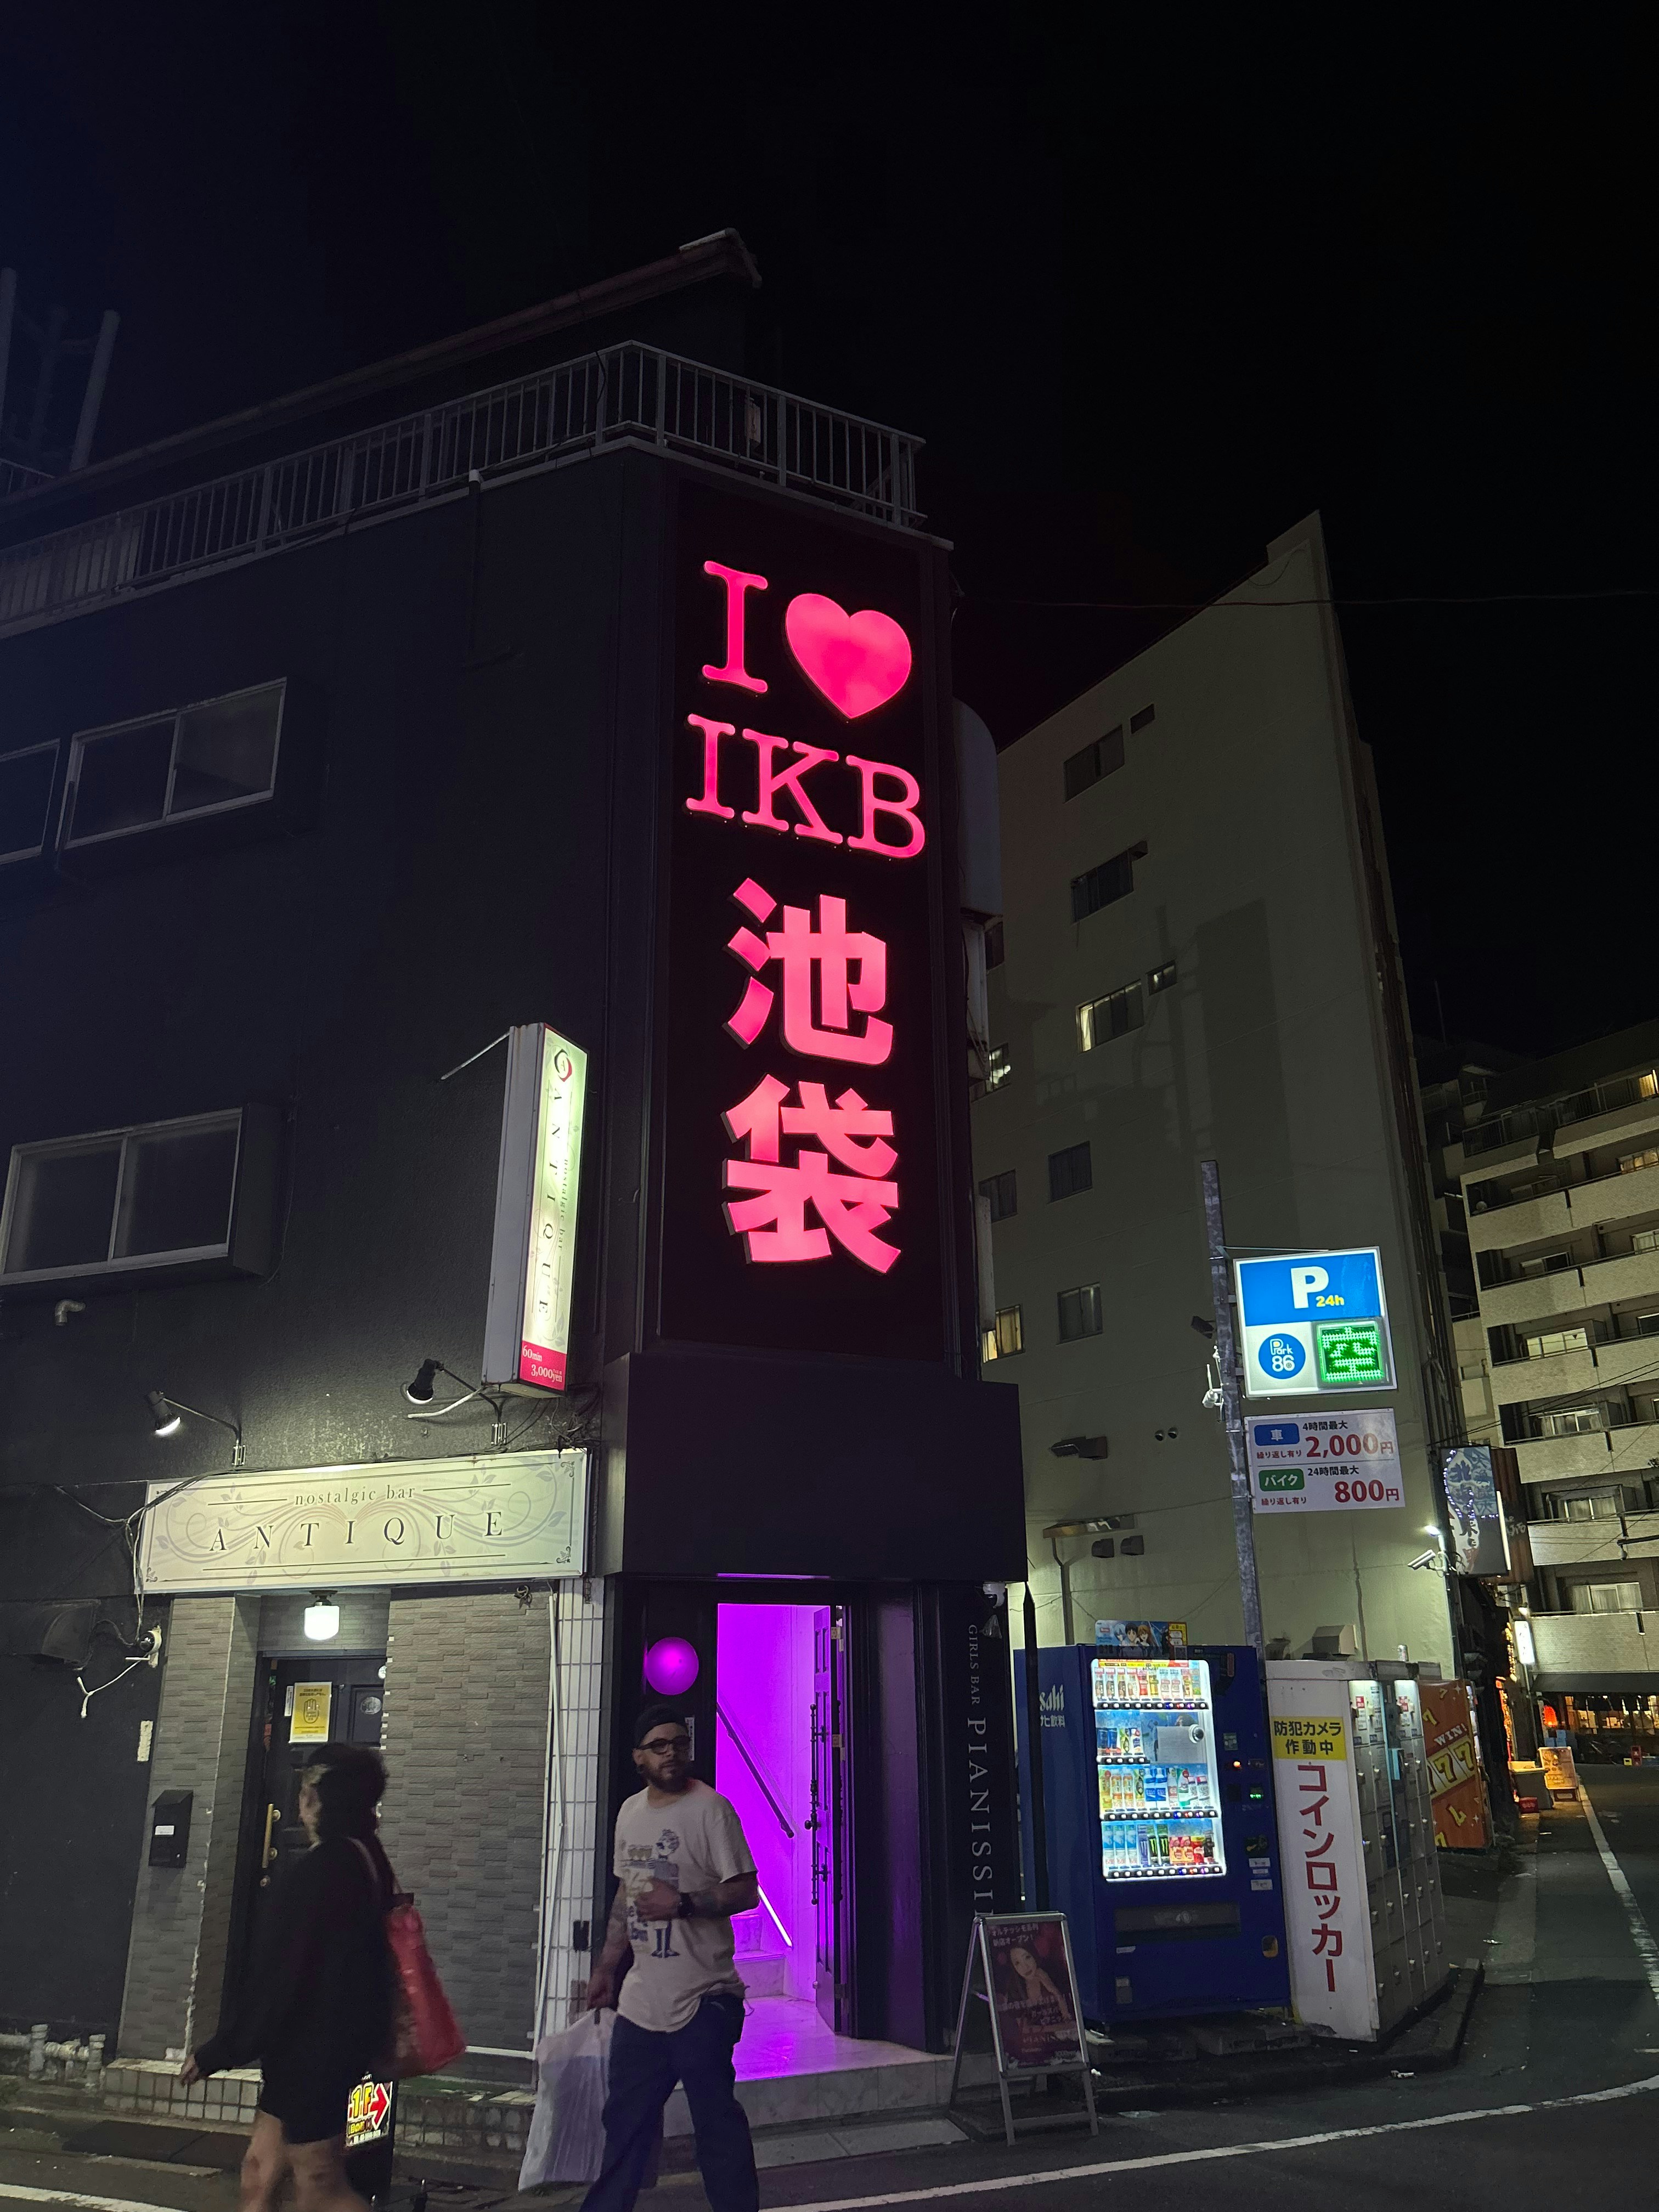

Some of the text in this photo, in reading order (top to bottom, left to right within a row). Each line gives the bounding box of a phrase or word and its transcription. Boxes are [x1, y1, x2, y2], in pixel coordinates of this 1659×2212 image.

[703, 561, 768, 693] I
[686, 713, 926, 859] IKB
[724, 878, 901, 1273] 池袋
[1291, 1266, 1345, 1309] P 24h
[522, 1345, 542, 1362] 60min
[1269, 1338, 1293, 1355] Park
[1321, 1327, 1383, 1382] 空
[1272, 1355, 1295, 1372] 86
[1271, 1429, 1284, 1441] 車
[1302, 1420, 1348, 1431] 4時間最大
[1257, 1449, 1302, 1459] 繰り返し有り
[1305, 1432, 1394, 1459] 2,000円
[1264, 1474, 1298, 1487] バイク
[1307, 1465, 1359, 1476] 24時間最大
[295, 1485, 416, 1506] nostalgic bar
[1261, 1497, 1307, 1506] 繰り返し有り
[1334, 1480, 1400, 1503] 800円
[209, 1511, 503, 1551] ANTIQUE
[968, 1624, 979, 1670] GIRLS
[970, 1676, 980, 1705] BAR
[1273, 1720, 1342, 1736] 防犯カメラ
[1434, 1723, 1468, 1747] WIN!
[1285, 1739, 1334, 1755] 作動中
[1297, 1764, 1344, 1993] コインロッカー
[353, 2085, 373, 2119] 1F
